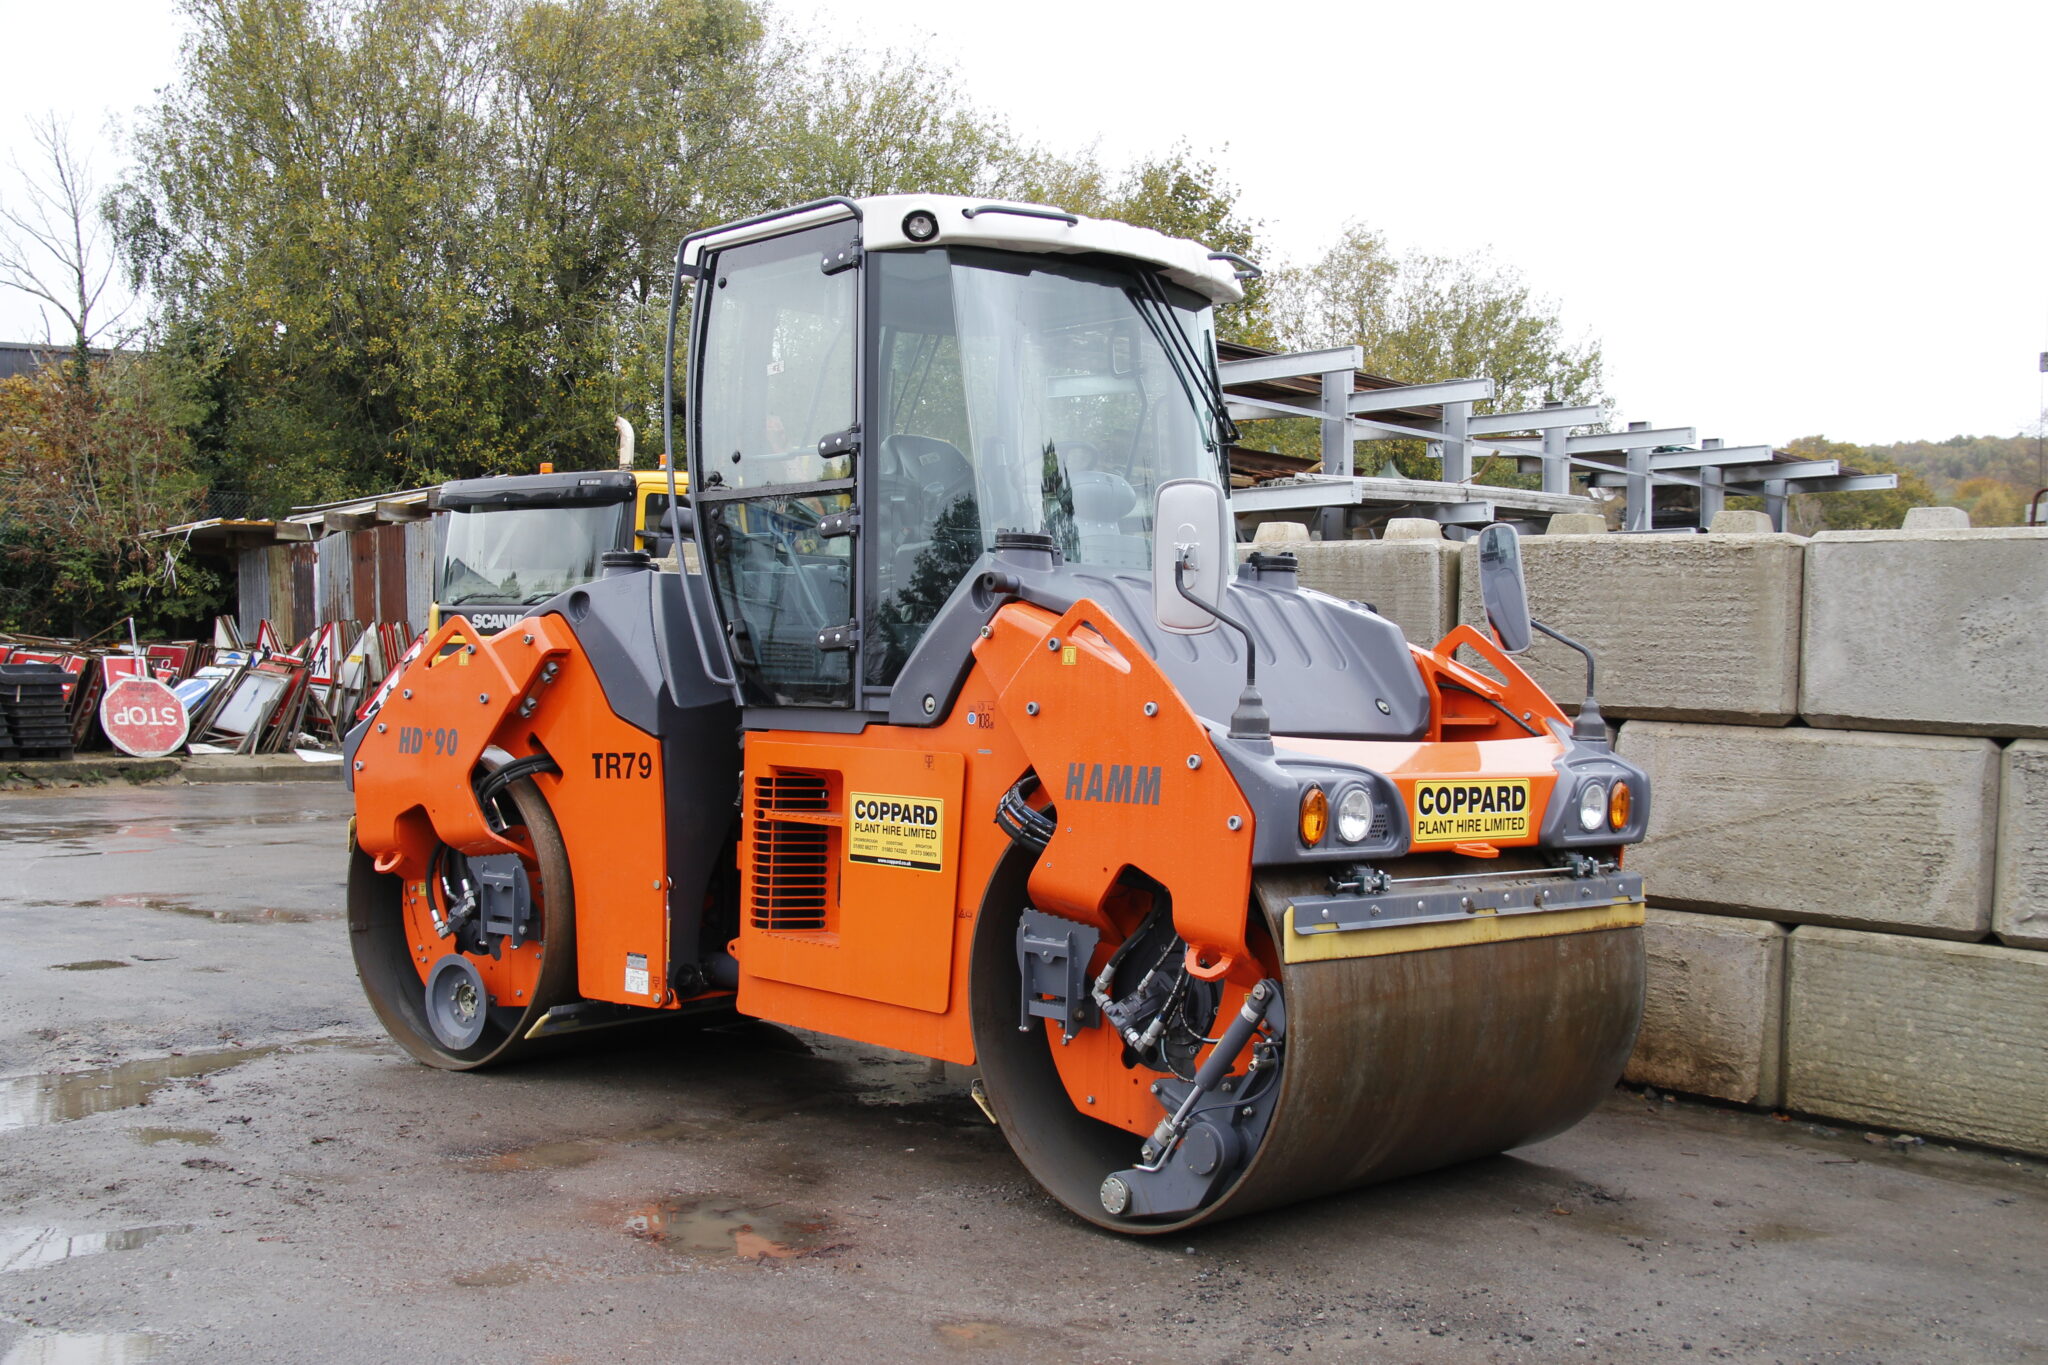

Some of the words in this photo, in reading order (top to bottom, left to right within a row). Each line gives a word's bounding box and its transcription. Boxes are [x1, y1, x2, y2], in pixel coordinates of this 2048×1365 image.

[113, 706, 178, 726] STOP
[592, 752, 652, 779] TR79
[1065, 762, 1162, 805] HAMM
[854, 799, 938, 826] COPPARD
[1418, 785, 1526, 815] COPPARD
[854, 822, 881, 834] PLANT
[882, 824, 902, 836] HIRE
[903, 827, 937, 840] LIMITED
[1418, 819, 1454, 835] PLANT
[1456, 818, 1482, 833] HIRE
[1484, 816, 1525, 832] LIMITED
